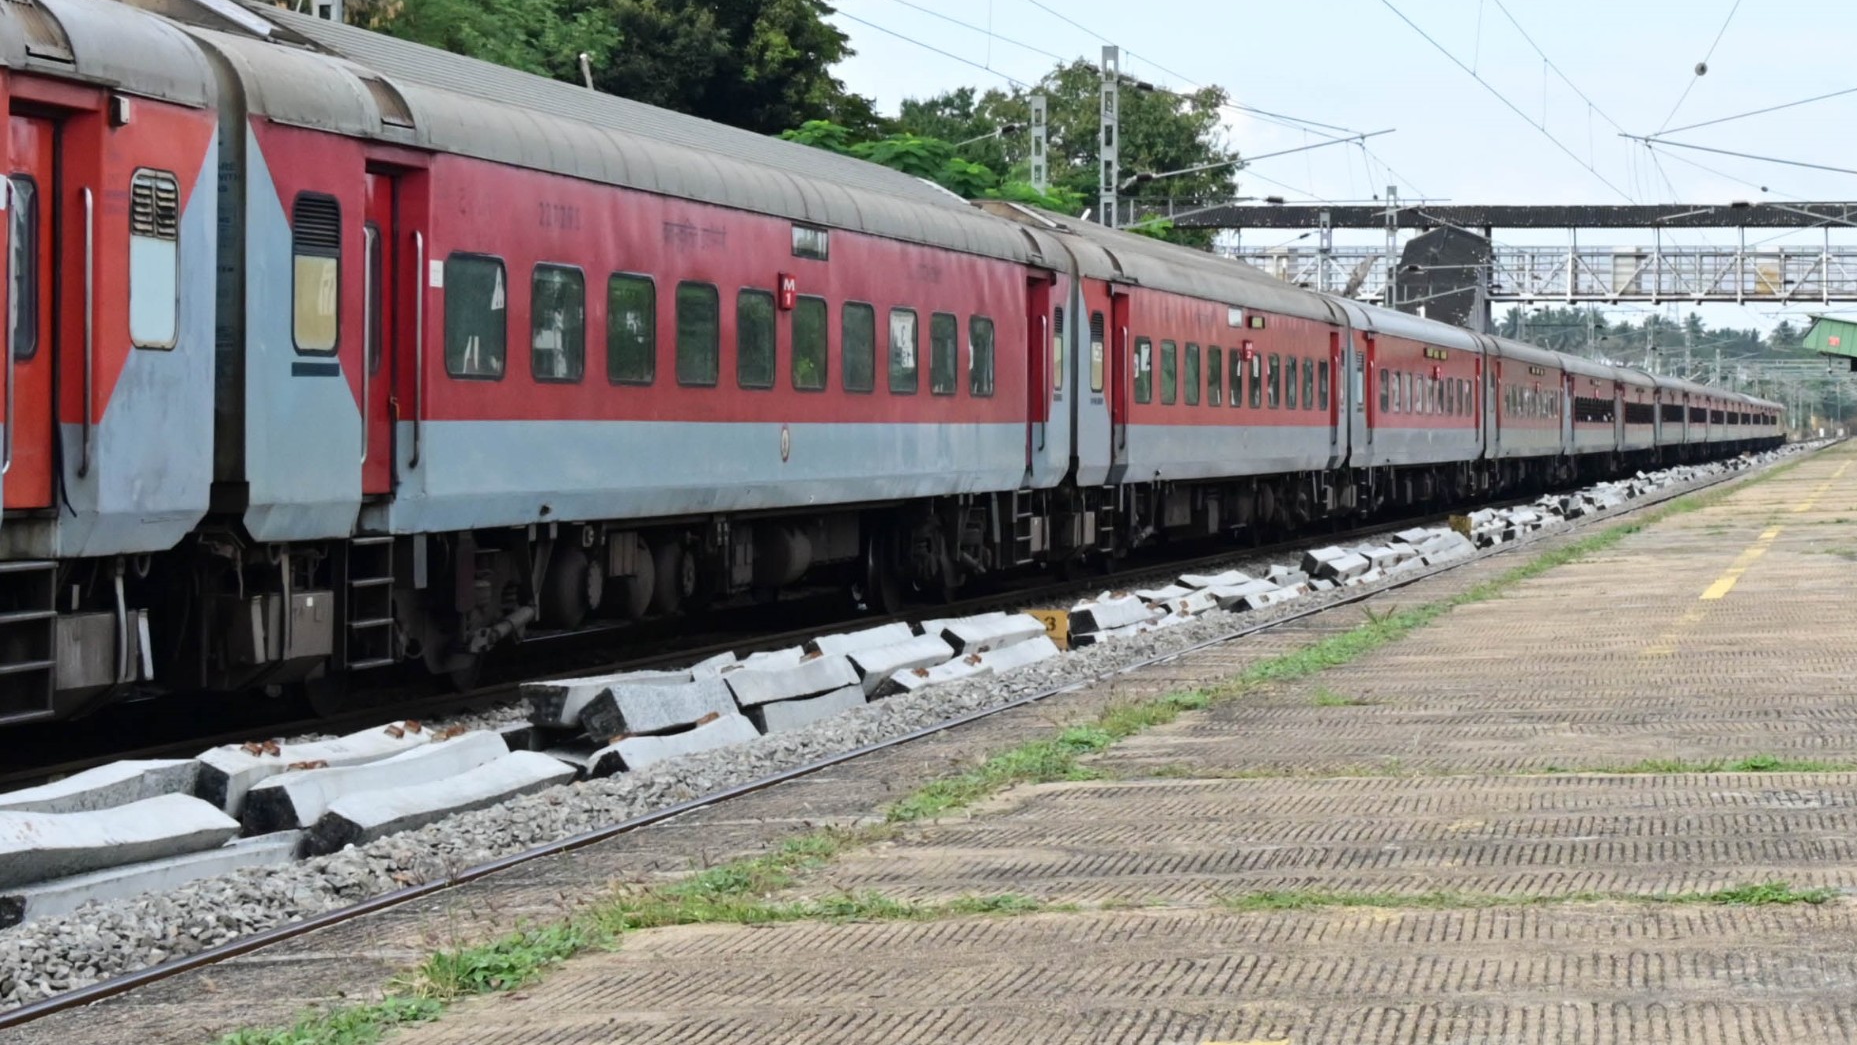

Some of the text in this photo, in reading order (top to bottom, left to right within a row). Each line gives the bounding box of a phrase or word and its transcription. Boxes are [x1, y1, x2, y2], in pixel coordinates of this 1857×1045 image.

[783, 278, 795, 291] M
[786, 292, 791, 305] 1
[1044, 616, 1056, 631] 3
